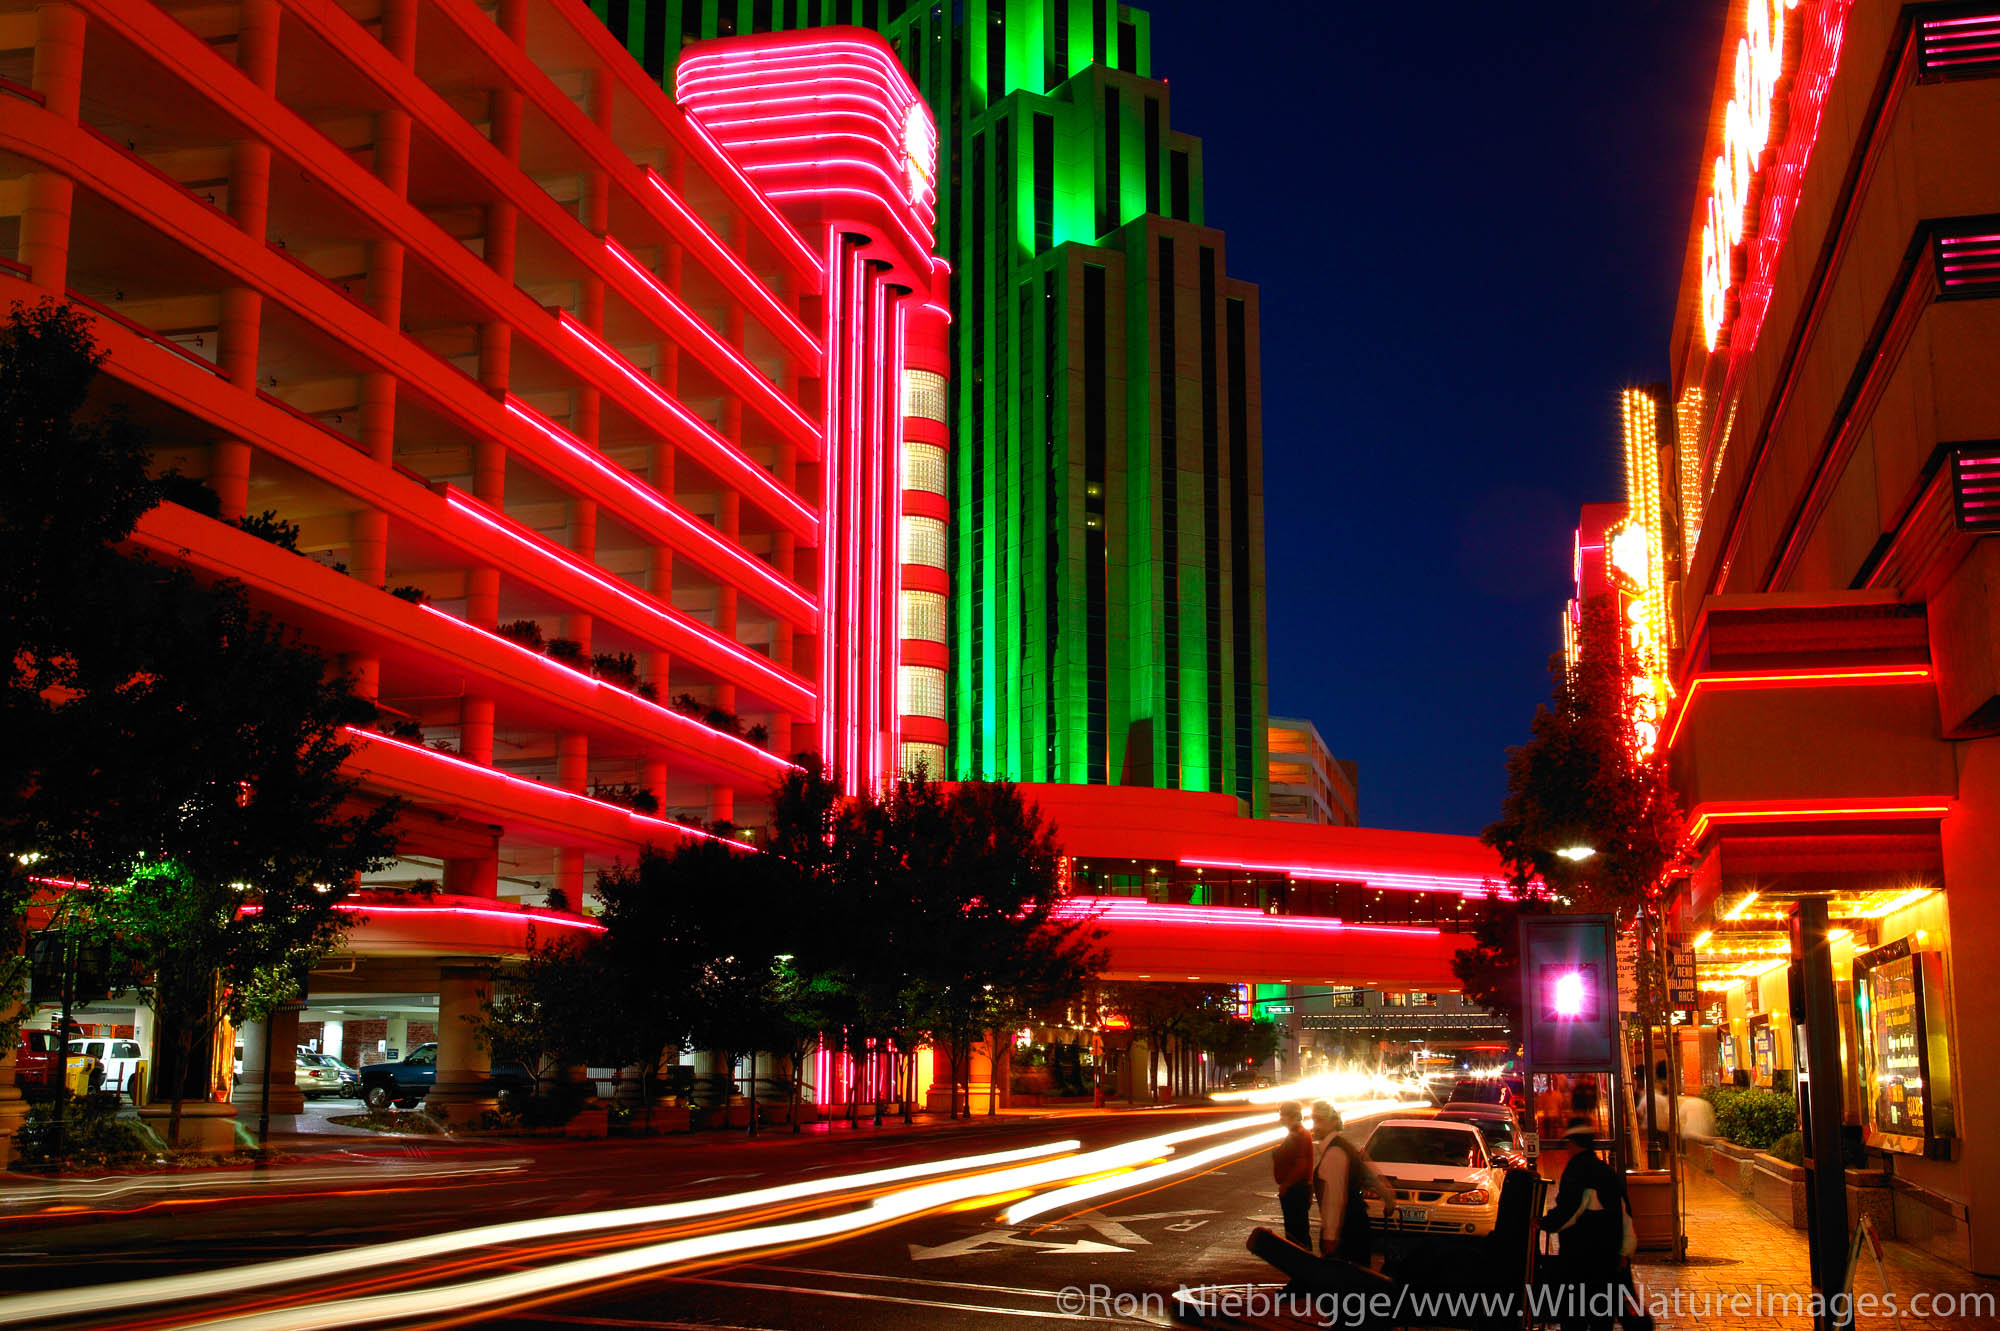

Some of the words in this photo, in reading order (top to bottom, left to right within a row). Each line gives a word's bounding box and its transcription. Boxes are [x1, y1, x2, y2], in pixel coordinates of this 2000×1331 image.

[1674, 955, 1692, 965] GREAT
[1677, 967, 1693, 977] RENO
[1678, 991, 1695, 1002] RACE
